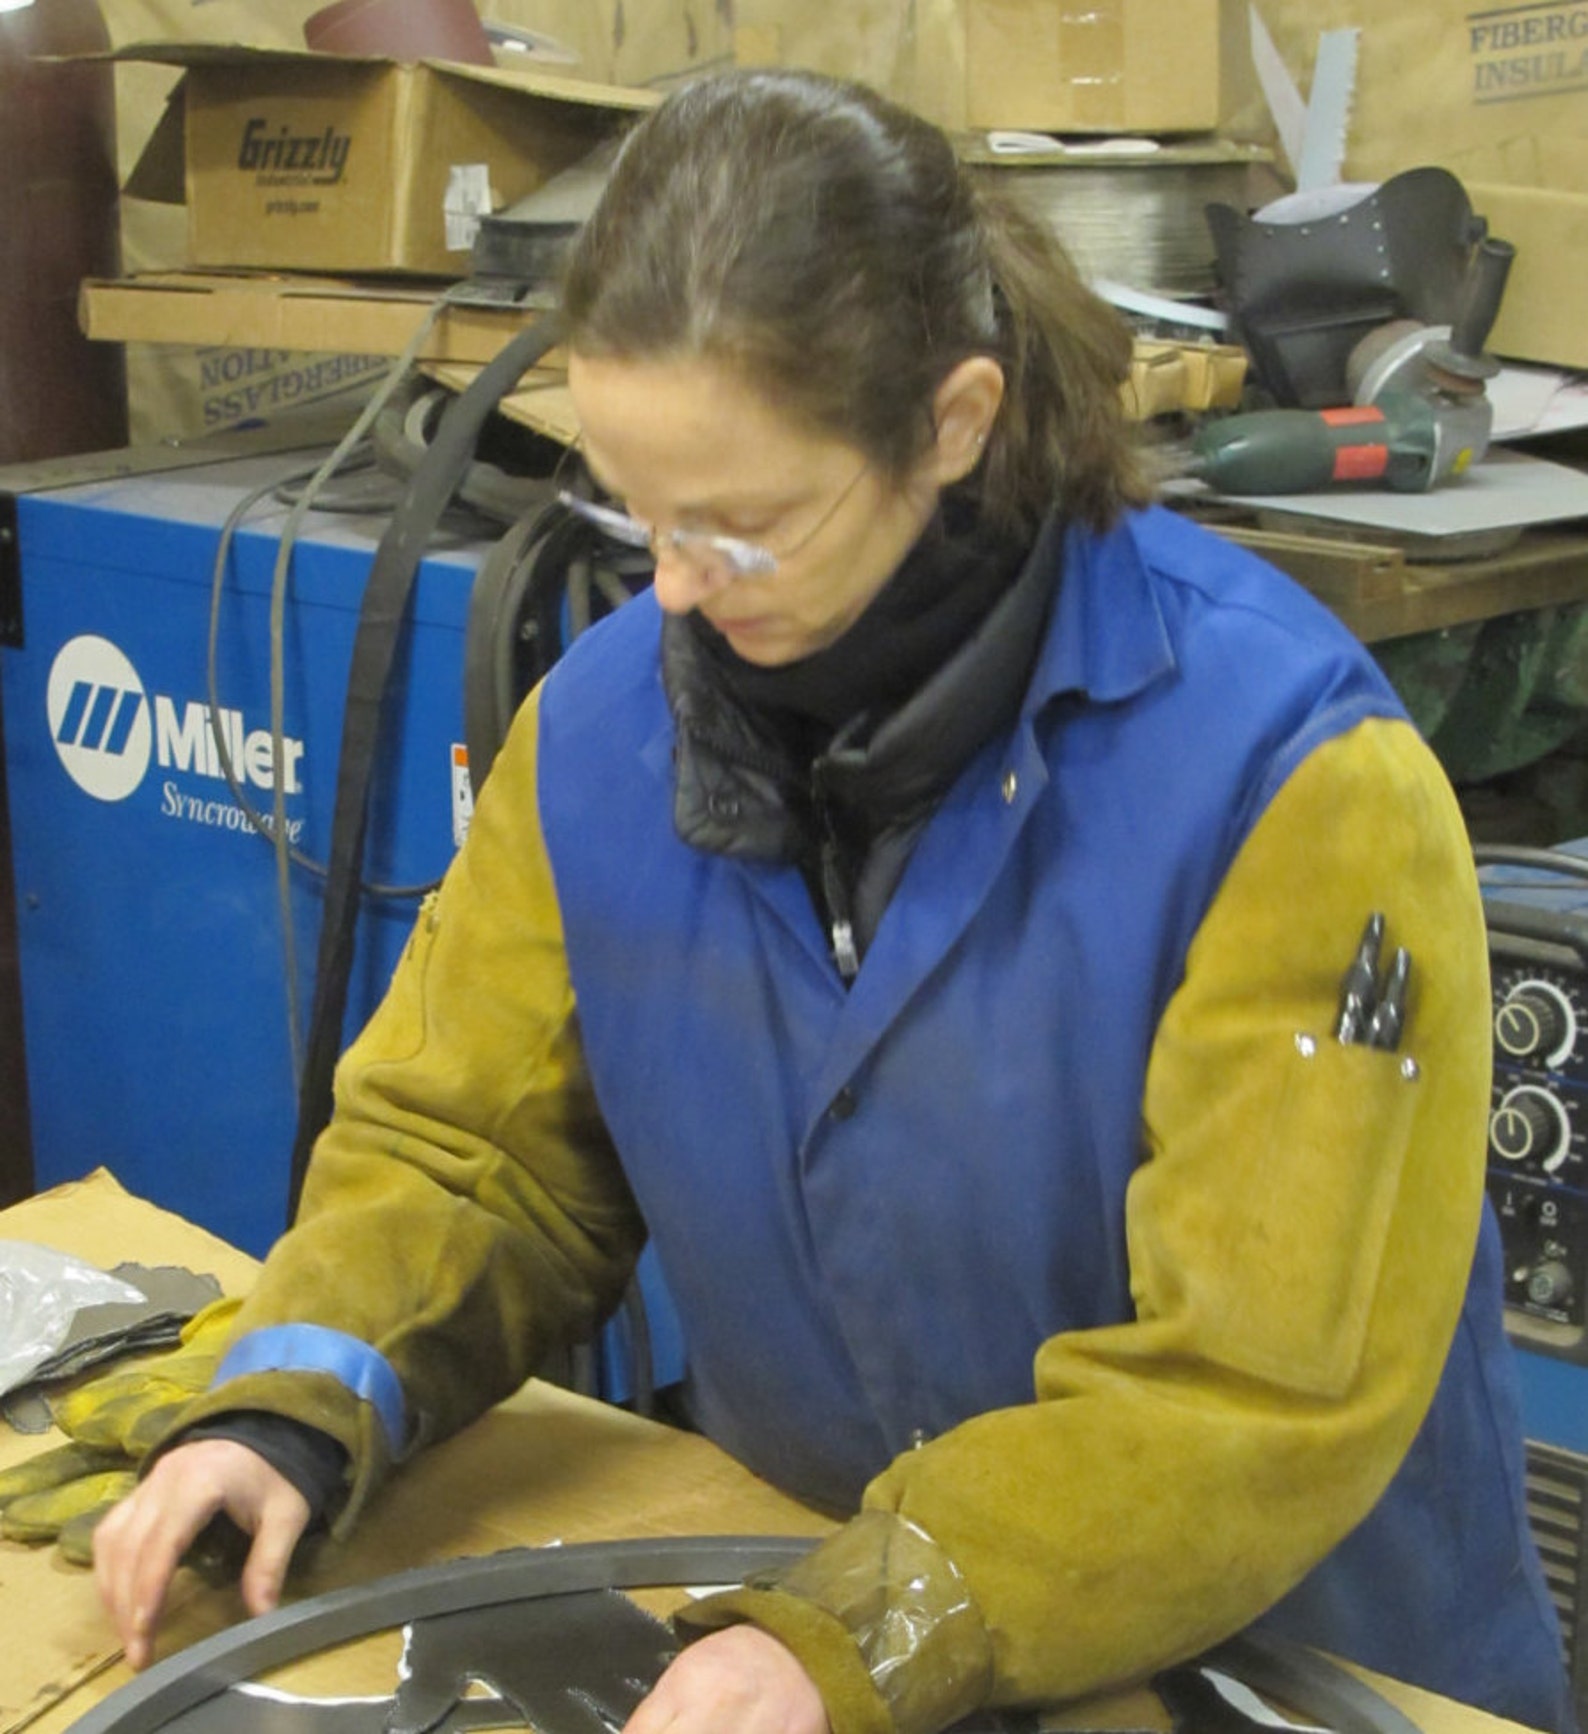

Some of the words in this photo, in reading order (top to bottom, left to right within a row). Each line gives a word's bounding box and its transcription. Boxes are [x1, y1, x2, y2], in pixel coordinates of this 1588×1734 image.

[1469, 9, 1588, 54] FIBERG
[238, 117, 351, 186] Grizzly
[155, 694, 304, 794] Miller
